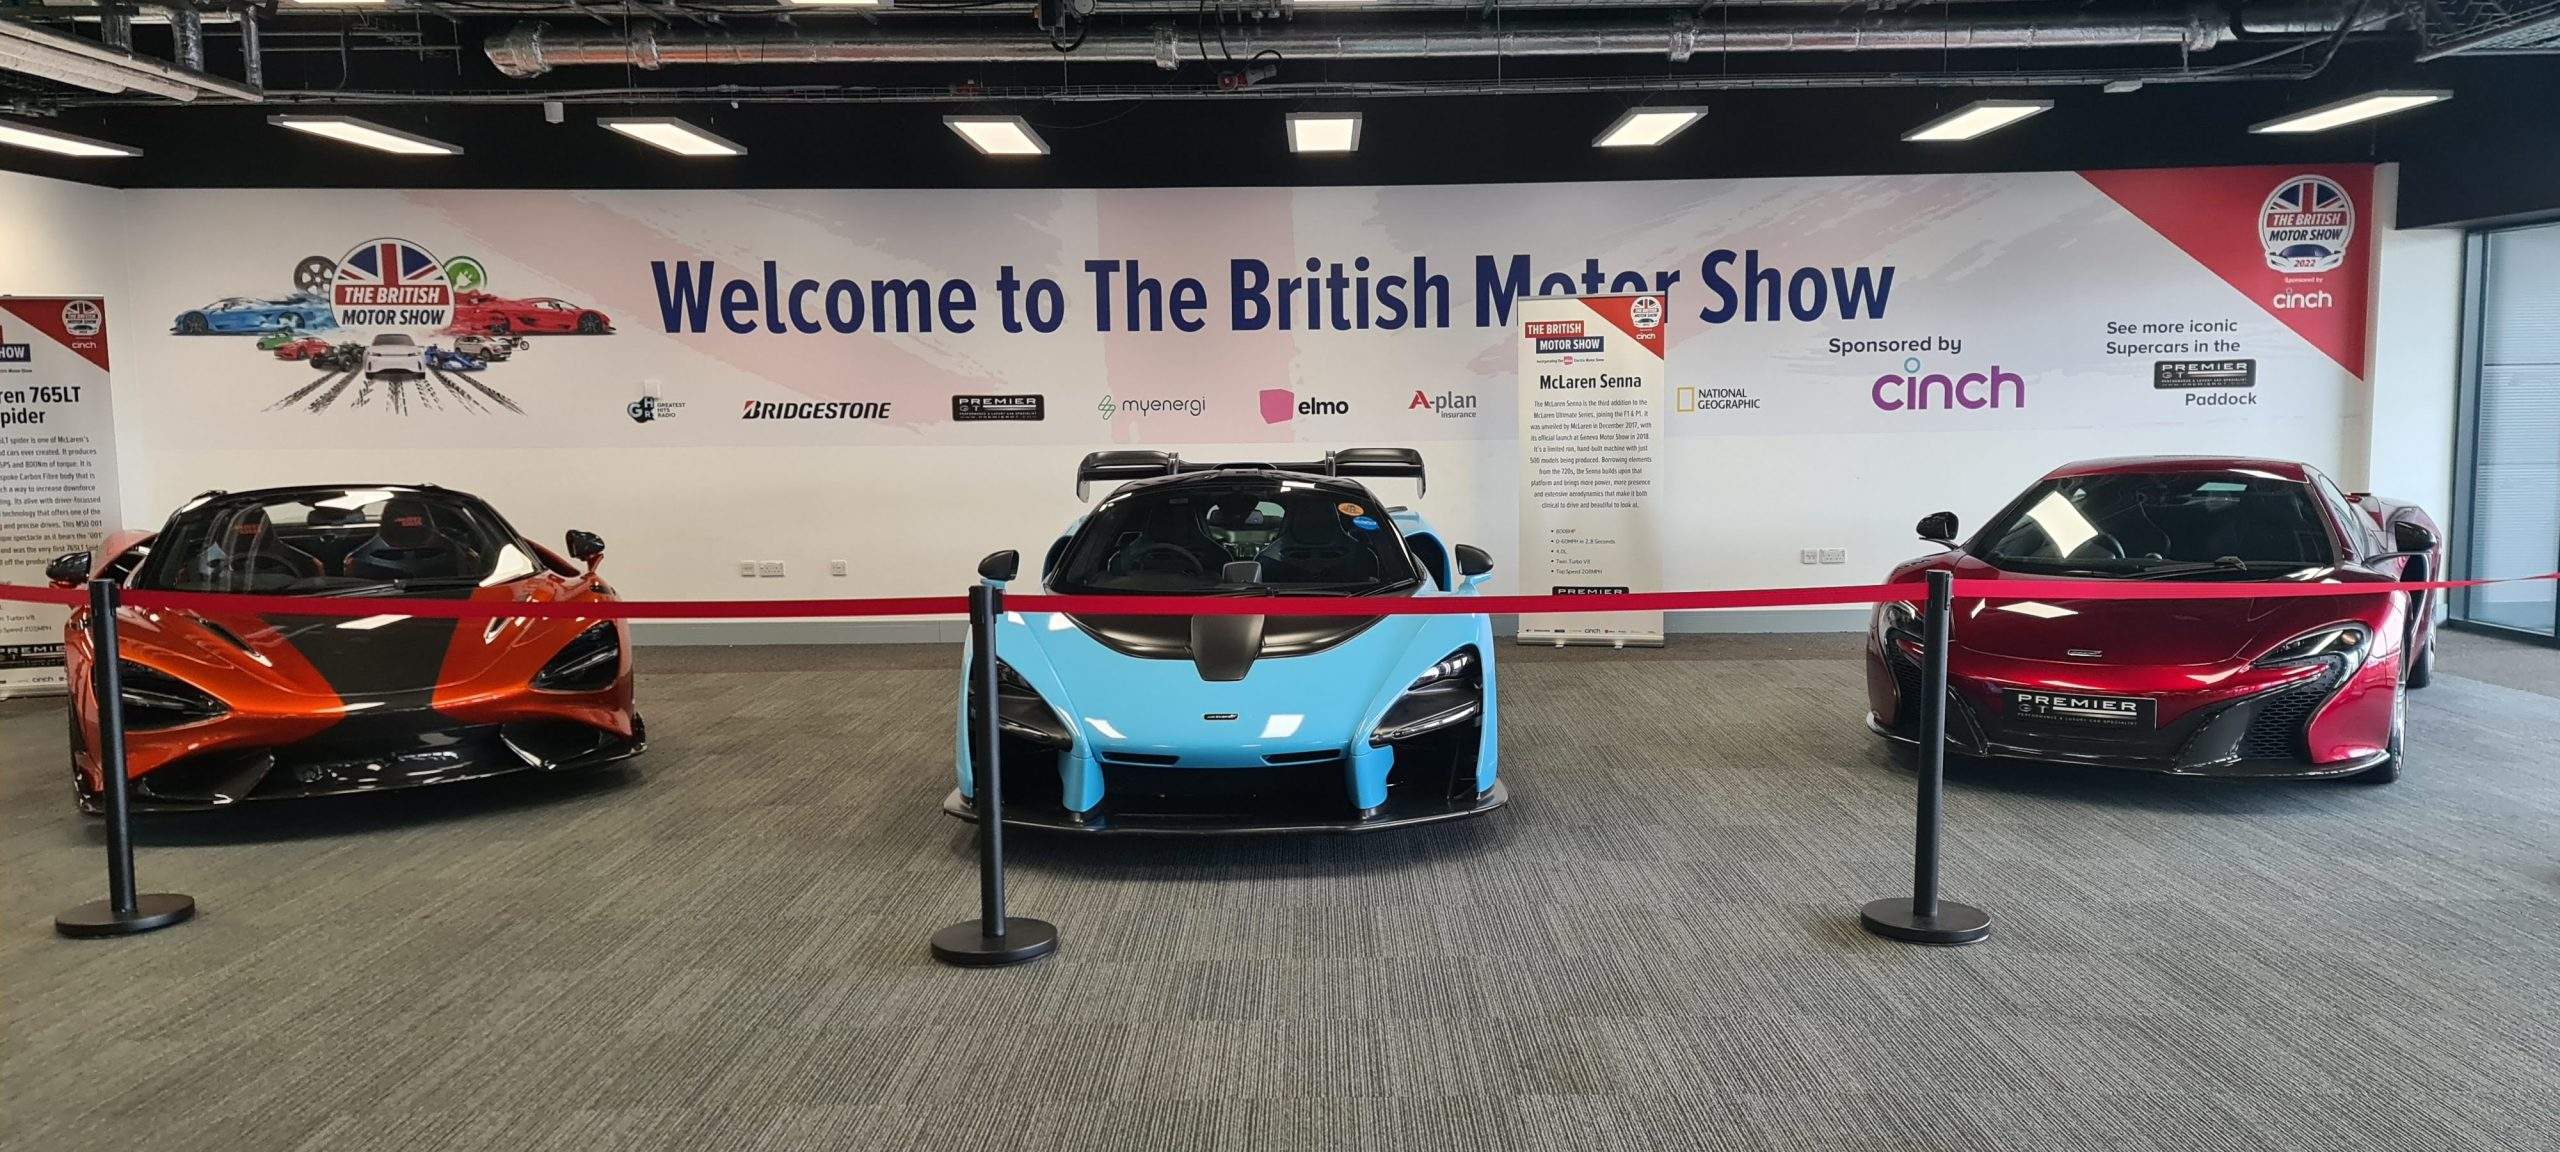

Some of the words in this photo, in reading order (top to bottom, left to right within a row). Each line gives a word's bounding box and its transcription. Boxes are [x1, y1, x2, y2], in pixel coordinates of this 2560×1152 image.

[2273, 213, 2295, 226] THE
[2295, 212, 2341, 226] BRITISH
[2269, 229, 2308, 241] MOTOR
[2310, 228, 2343, 241] SHOW
[2294, 259, 2316, 267] 2022
[2285, 276, 2315, 284] Sponsored
[344, 287, 375, 304] THE
[377, 287, 440, 304] BRITISH
[651, 260, 977, 334] Welcome
[996, 264, 1066, 333] to
[1084, 259, 1208, 332] The
[1230, 255, 1450, 331] British
[1699, 248, 1896, 324] Show
[2273, 287, 2332, 309] cinch
[341, 309, 397, 326] MOTOR
[399, 309, 445, 326] SHOW
[1528, 324, 1545, 335] THE
[1546, 323, 1582, 335] BRITISH
[2106, 321, 2138, 335] See
[2142, 321, 2184, 334] more
[2189, 319, 2237, 333] iconic
[1636, 332, 1656, 340] cinch
[71, 341, 97, 349] cinch
[1540, 340, 1572, 351] MOTOR
[1573, 338, 1600, 350] SHOW
[1828, 336, 1932, 356] Sponsored
[1938, 336, 1962, 355] by
[2106, 341, 2188, 357] Supercars
[2194, 340, 2208, 353] in
[2214, 340, 2240, 353] the
[2162, 363, 2248, 371] PREMIER
[1540, 374, 1597, 389] McLaren
[1600, 373, 1642, 388] Senna
[1871, 357, 2026, 412] cinch
[29, 387, 81, 403] 765LT
[1698, 388, 1747, 399] NATIONAL
[2185, 392, 2257, 406] Paddock
[959, 397, 1037, 405] PREMIER
[1122, 396, 1206, 417] myenergi
[1298, 399, 1349, 416] elmo
[1409, 390, 1477, 413] A-plan
[1697, 398, 1761, 411] GEOGRAPHIC
[742, 400, 891, 420] BRIDGESTONE
[1440, 411, 1477, 419] insurance
[1596, 411, 1614, 419] joining
[1625, 422, 1639, 430] 2017,
[1602, 456, 1628, 464] Borrowing
[2018, 694, 2137, 711] PREMIER
[2018, 703, 2049, 714] GT
